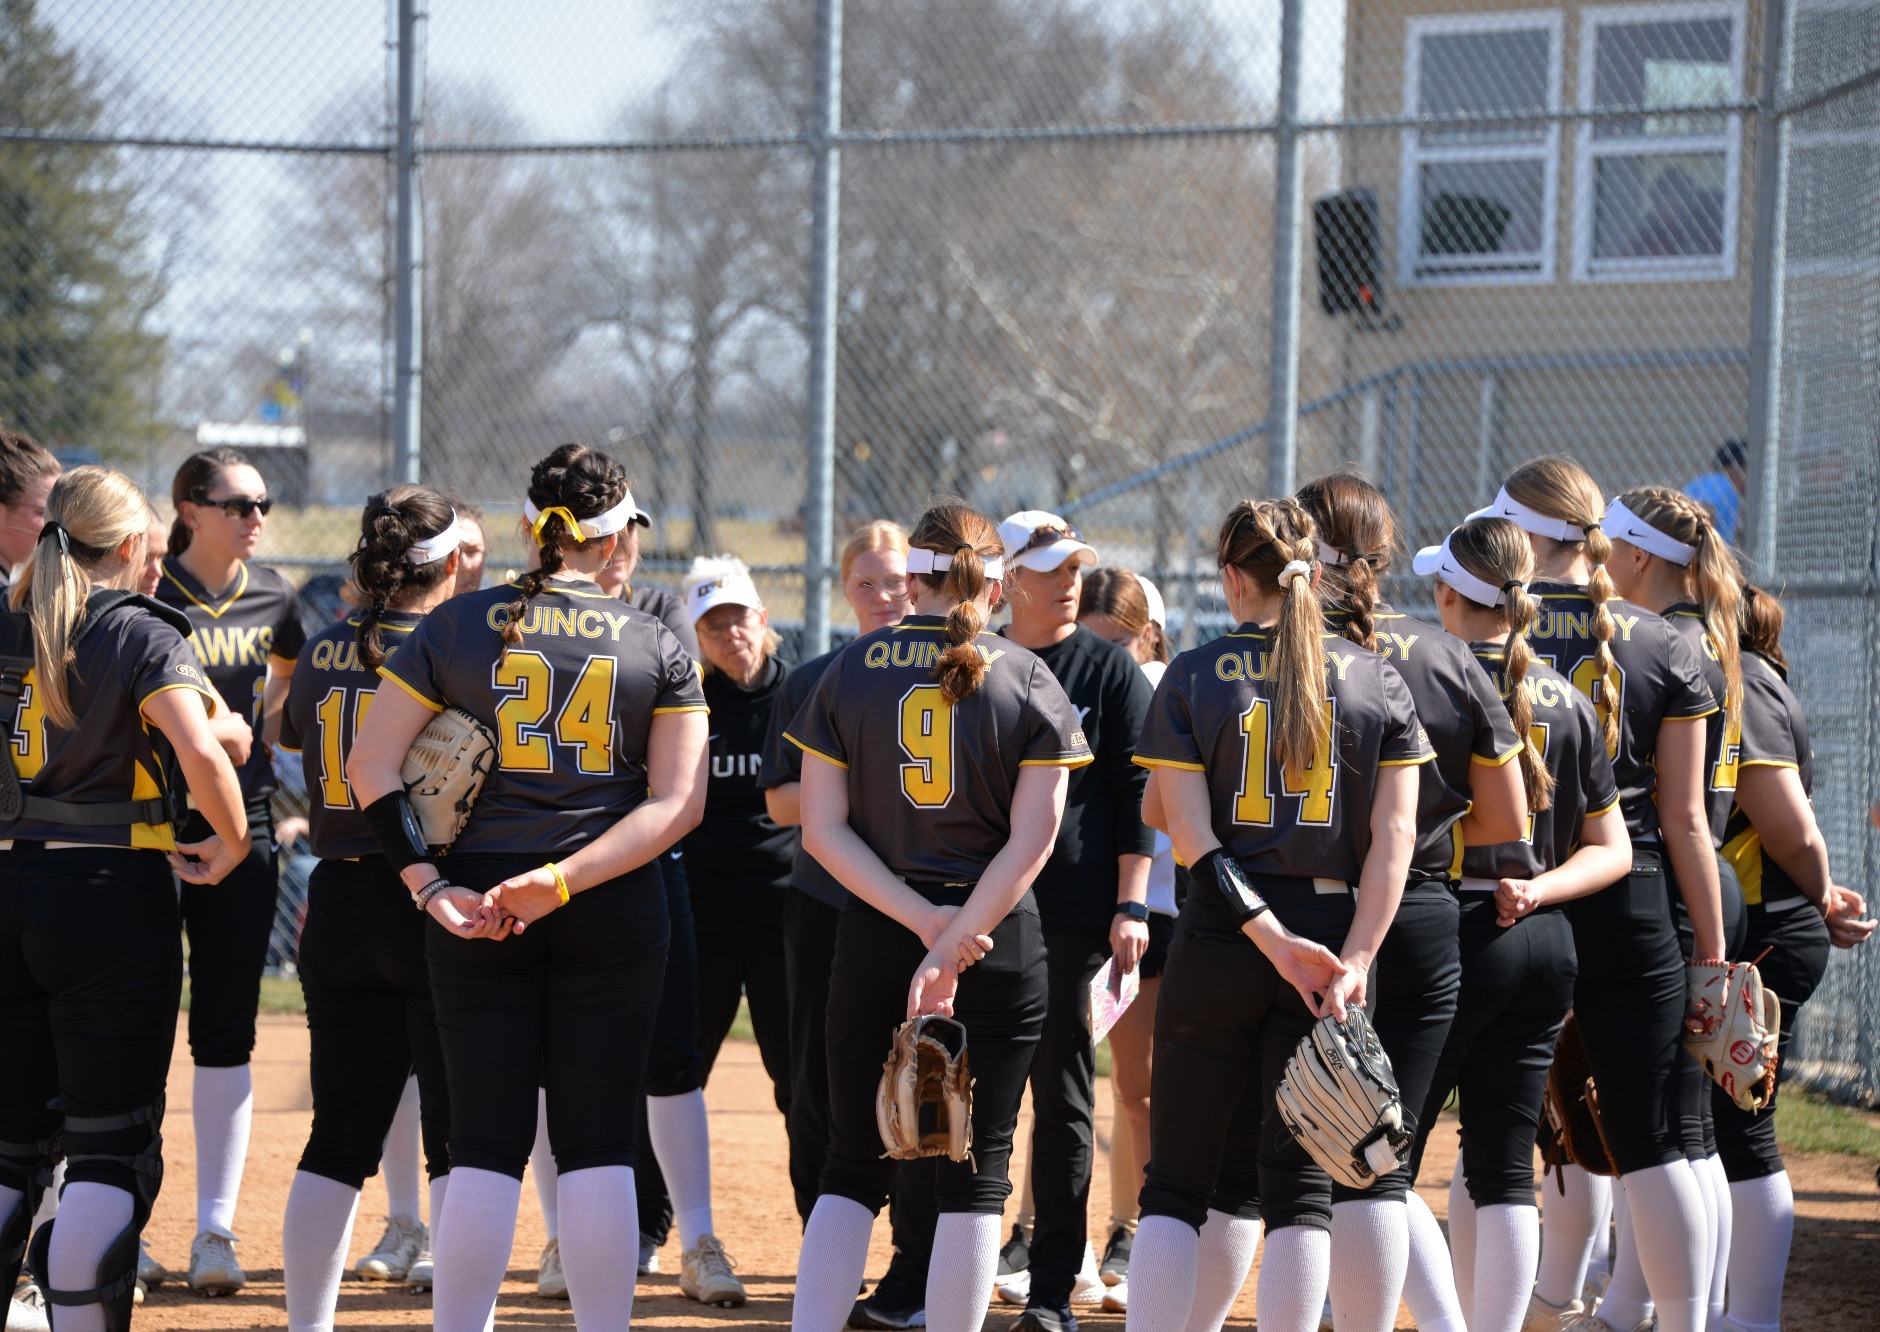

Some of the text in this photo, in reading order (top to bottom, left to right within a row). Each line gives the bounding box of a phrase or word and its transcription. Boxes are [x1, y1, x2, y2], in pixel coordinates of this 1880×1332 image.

[187, 626, 273, 667] AWKS
[487, 603, 630, 641] QUINCY
[865, 641, 1005, 672] QUINY
[492, 649, 618, 776] 24
[899, 684, 955, 809] 9
[1232, 696, 1338, 828] 14
